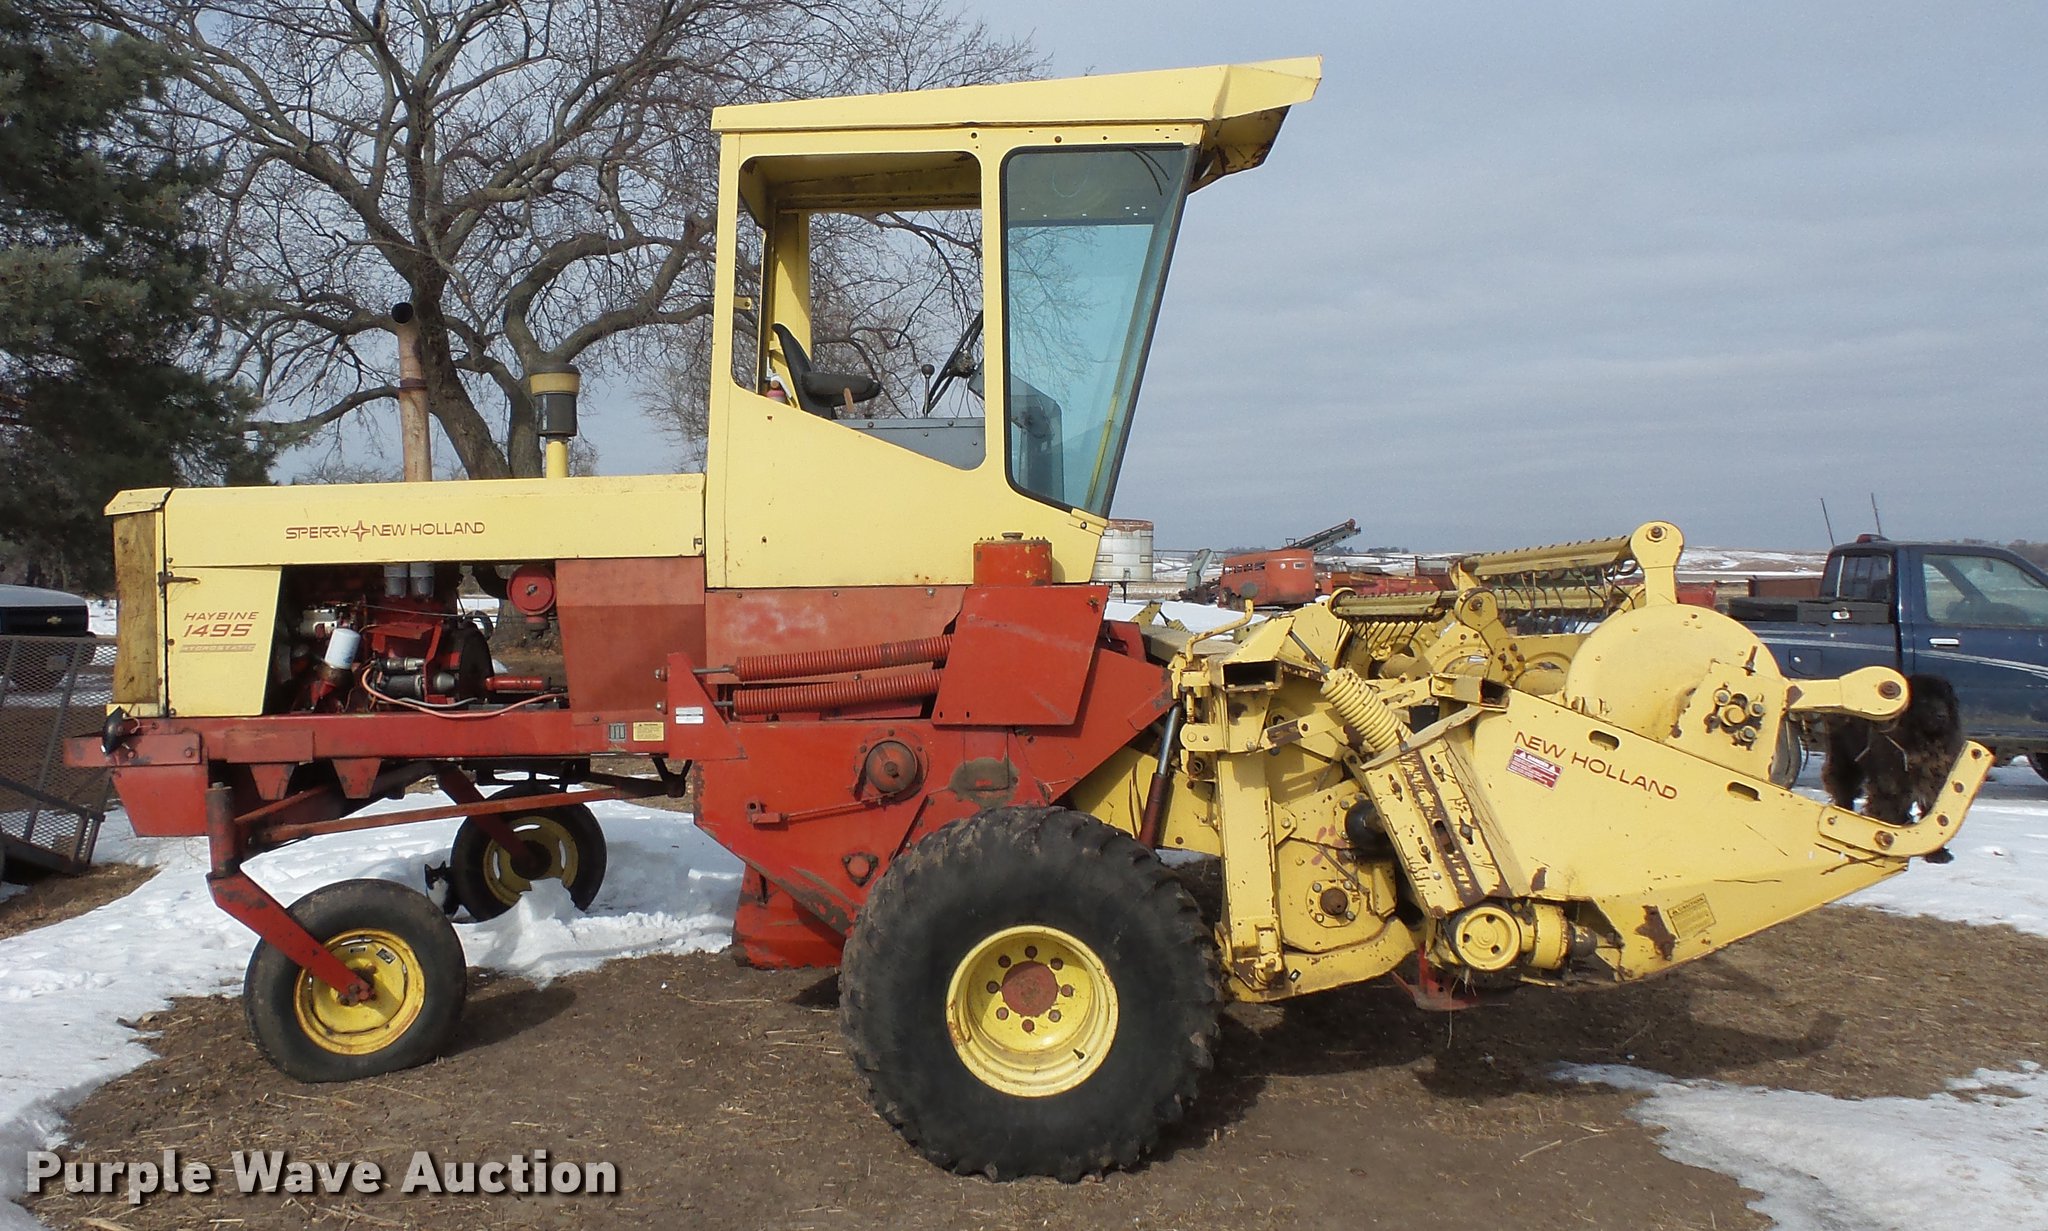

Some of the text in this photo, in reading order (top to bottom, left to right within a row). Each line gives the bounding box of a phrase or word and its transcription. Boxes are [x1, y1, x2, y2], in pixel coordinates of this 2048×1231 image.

[286, 522, 485, 540] SPERRY NEW HOLLAND
[183, 611, 259, 621] HAYBINE
[183, 624, 253, 638] 1495
[1514, 731, 1566, 759] NEW
[1571, 752, 1677, 800] HOLLAND
